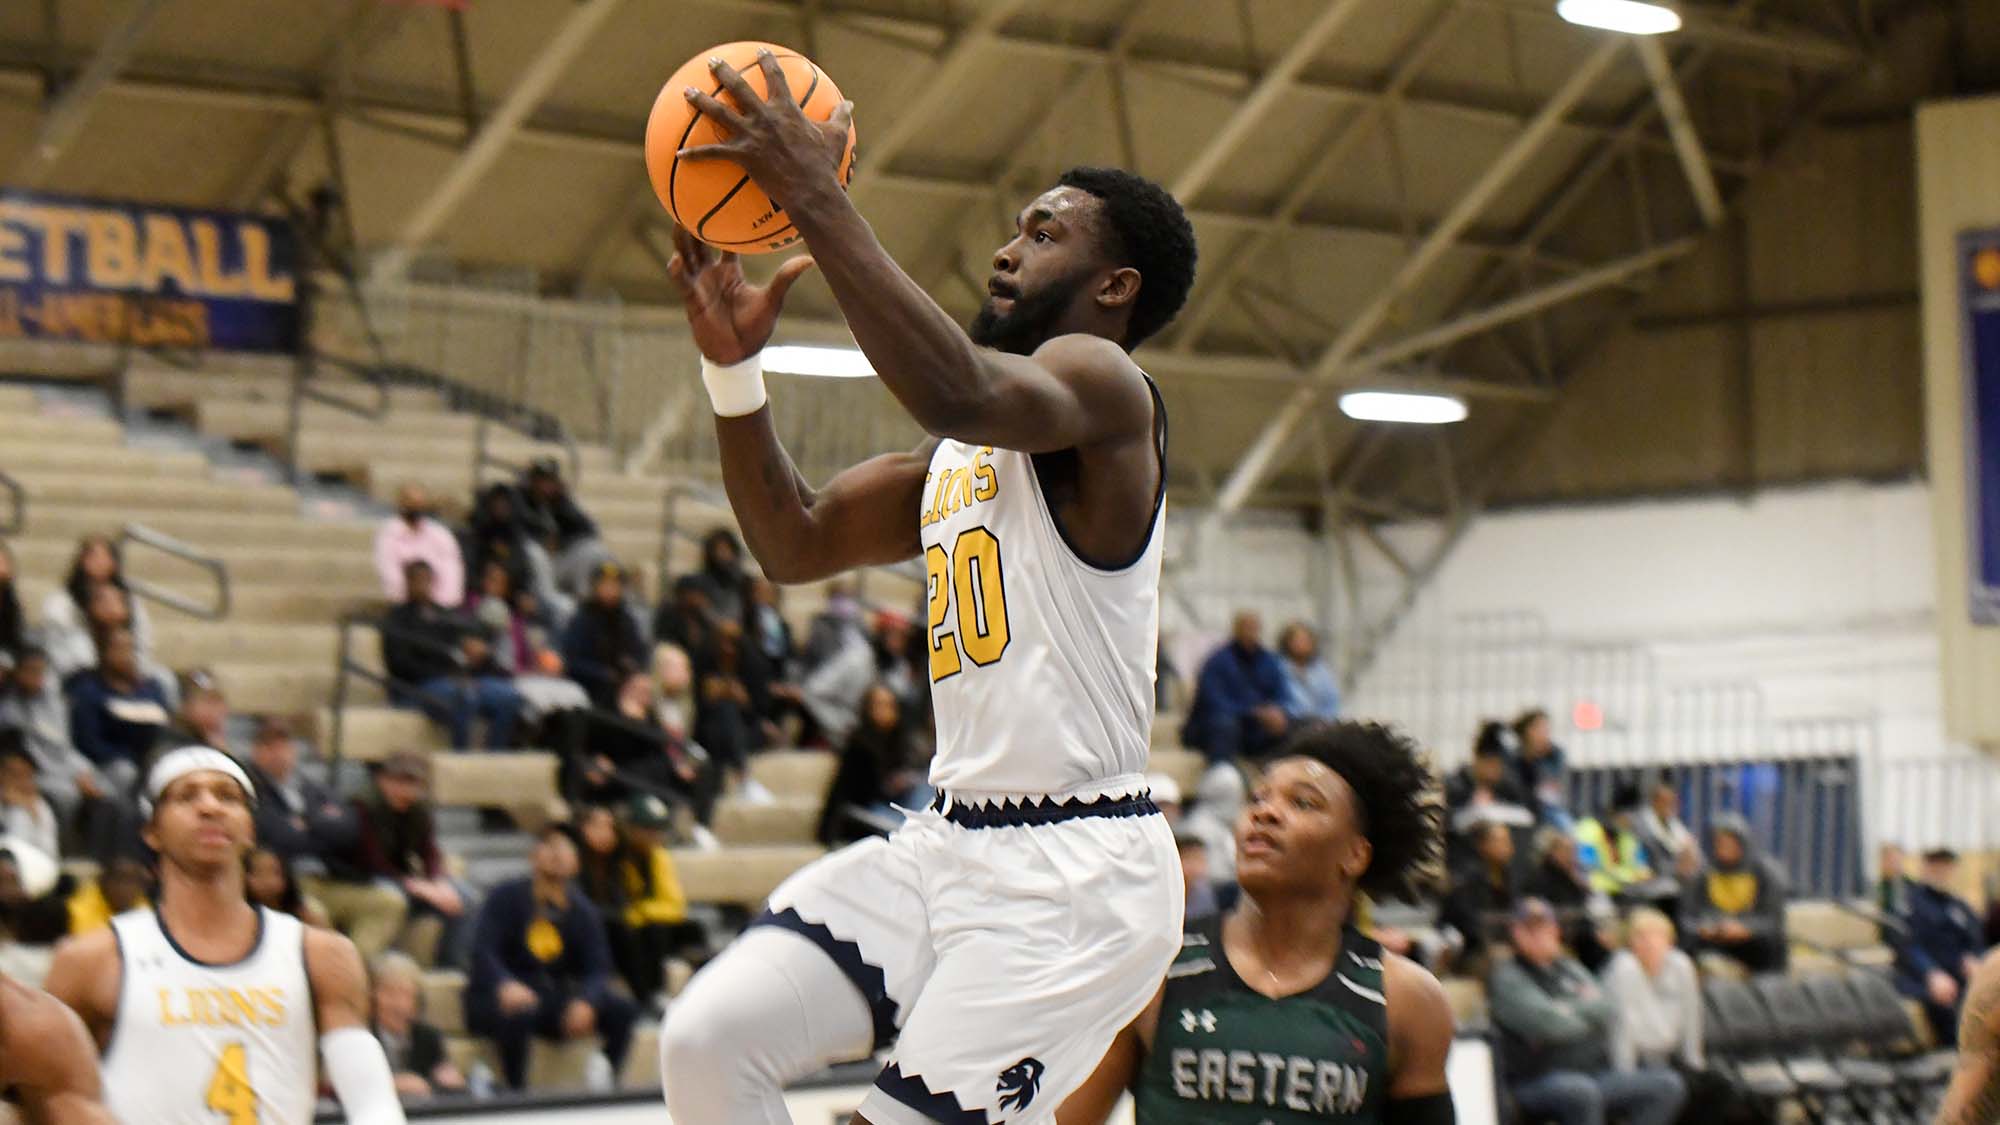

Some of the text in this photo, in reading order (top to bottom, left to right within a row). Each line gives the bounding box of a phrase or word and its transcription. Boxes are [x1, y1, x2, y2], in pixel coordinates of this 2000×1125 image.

[920, 445, 999, 529] LIONS
[926, 525, 1011, 684] 20
[158, 986, 287, 1026] LIONS
[204, 1041, 260, 1125] 4
[1170, 1047, 1369, 1116] EASTERN
